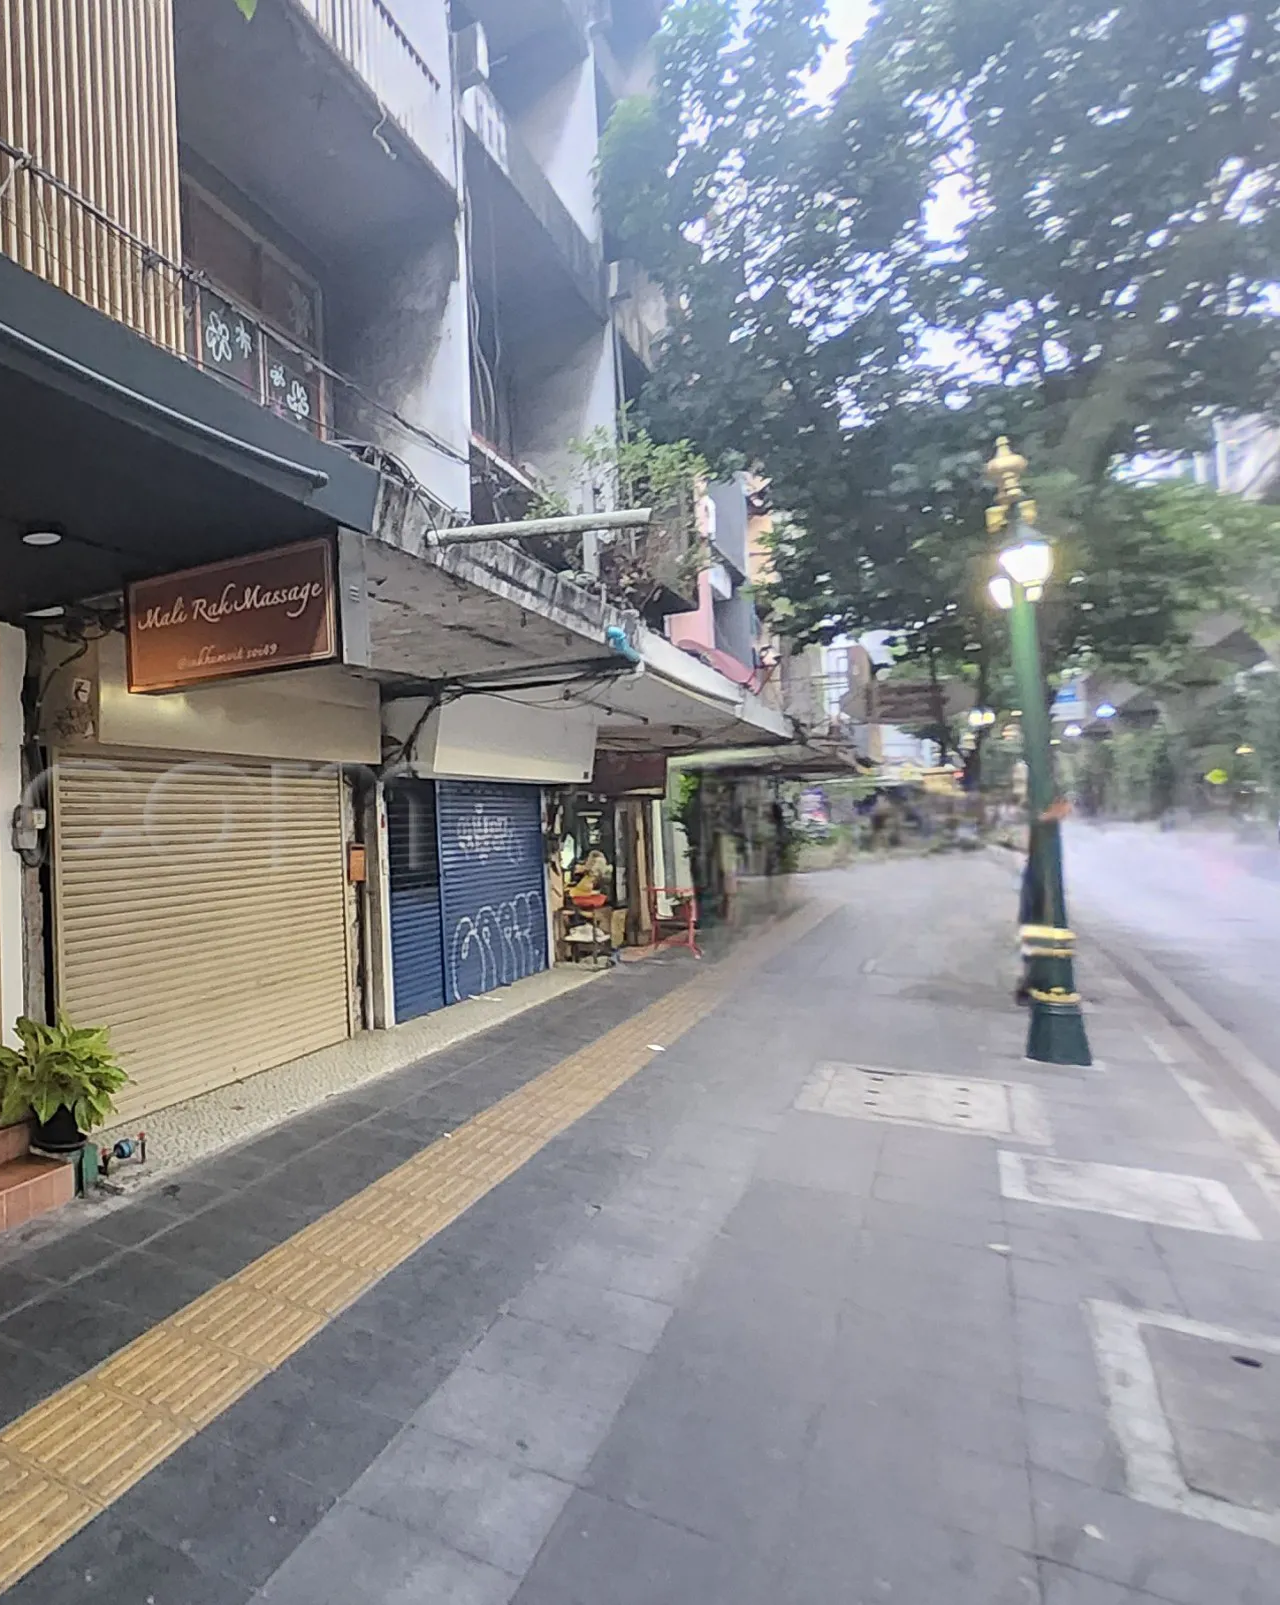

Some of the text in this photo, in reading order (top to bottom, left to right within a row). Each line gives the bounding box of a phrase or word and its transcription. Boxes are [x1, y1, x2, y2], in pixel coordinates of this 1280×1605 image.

[138, 581, 323, 631] Mali Rak Massage
